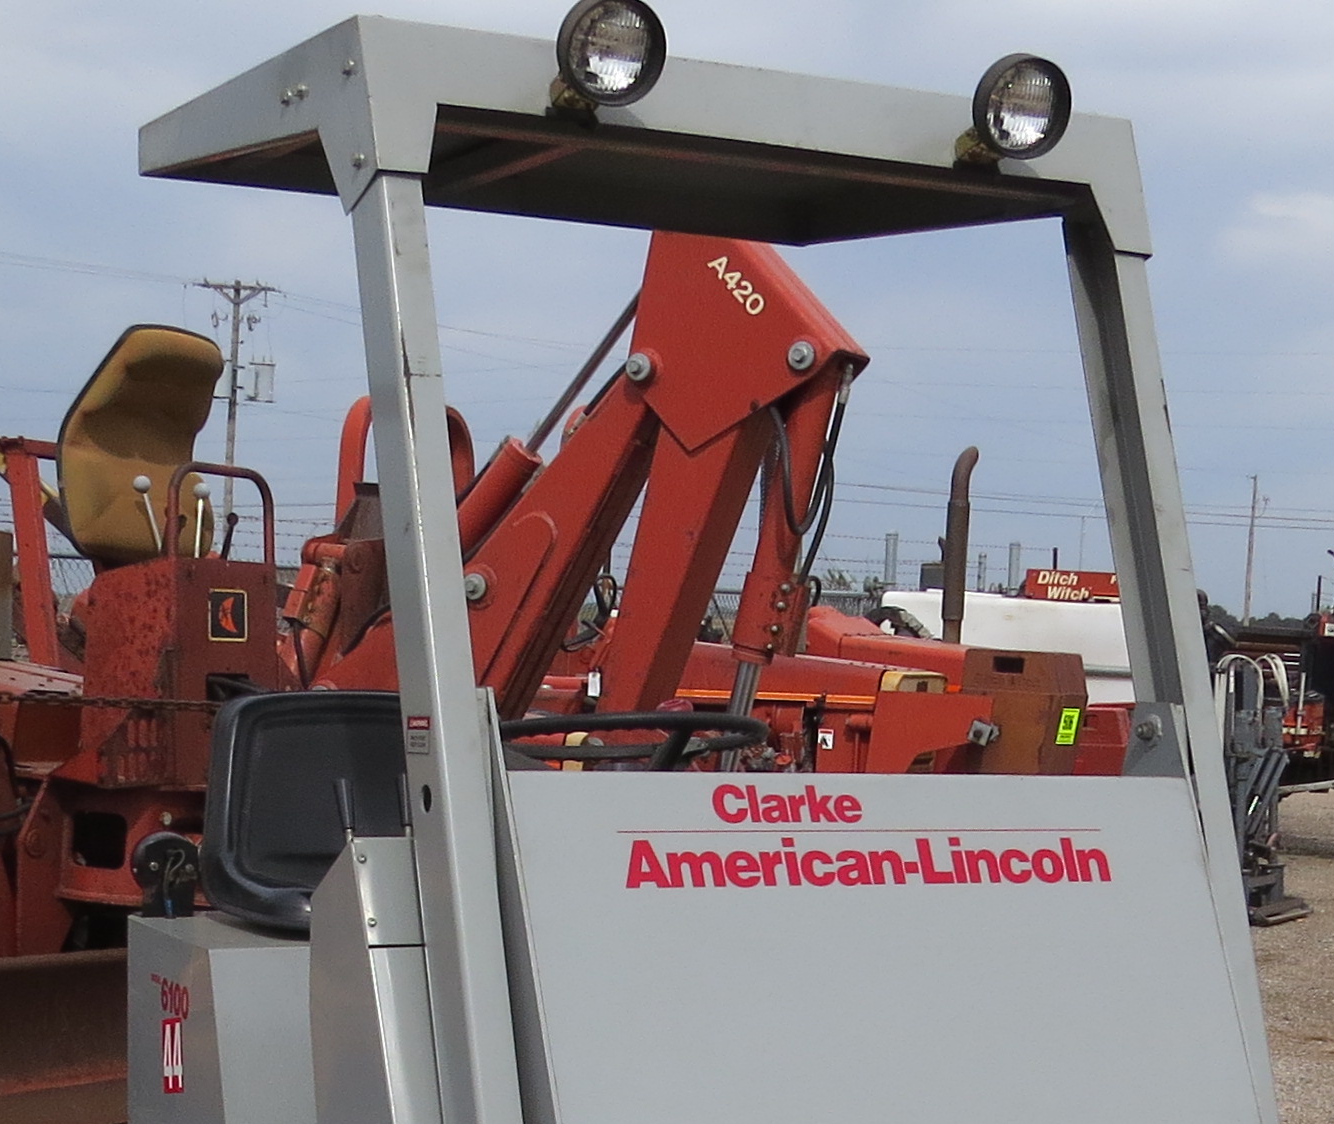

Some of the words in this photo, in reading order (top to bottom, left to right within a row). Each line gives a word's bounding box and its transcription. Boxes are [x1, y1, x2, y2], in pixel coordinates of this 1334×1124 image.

[707, 256, 765, 315] A420
[1037, 571, 1078, 586] Ditch
[1047, 586, 1089, 600] Witch
[711, 783, 864, 825] Clarke
[625, 837, 1113, 889] American-Lincoln
[161, 977, 189, 1020] 6100
